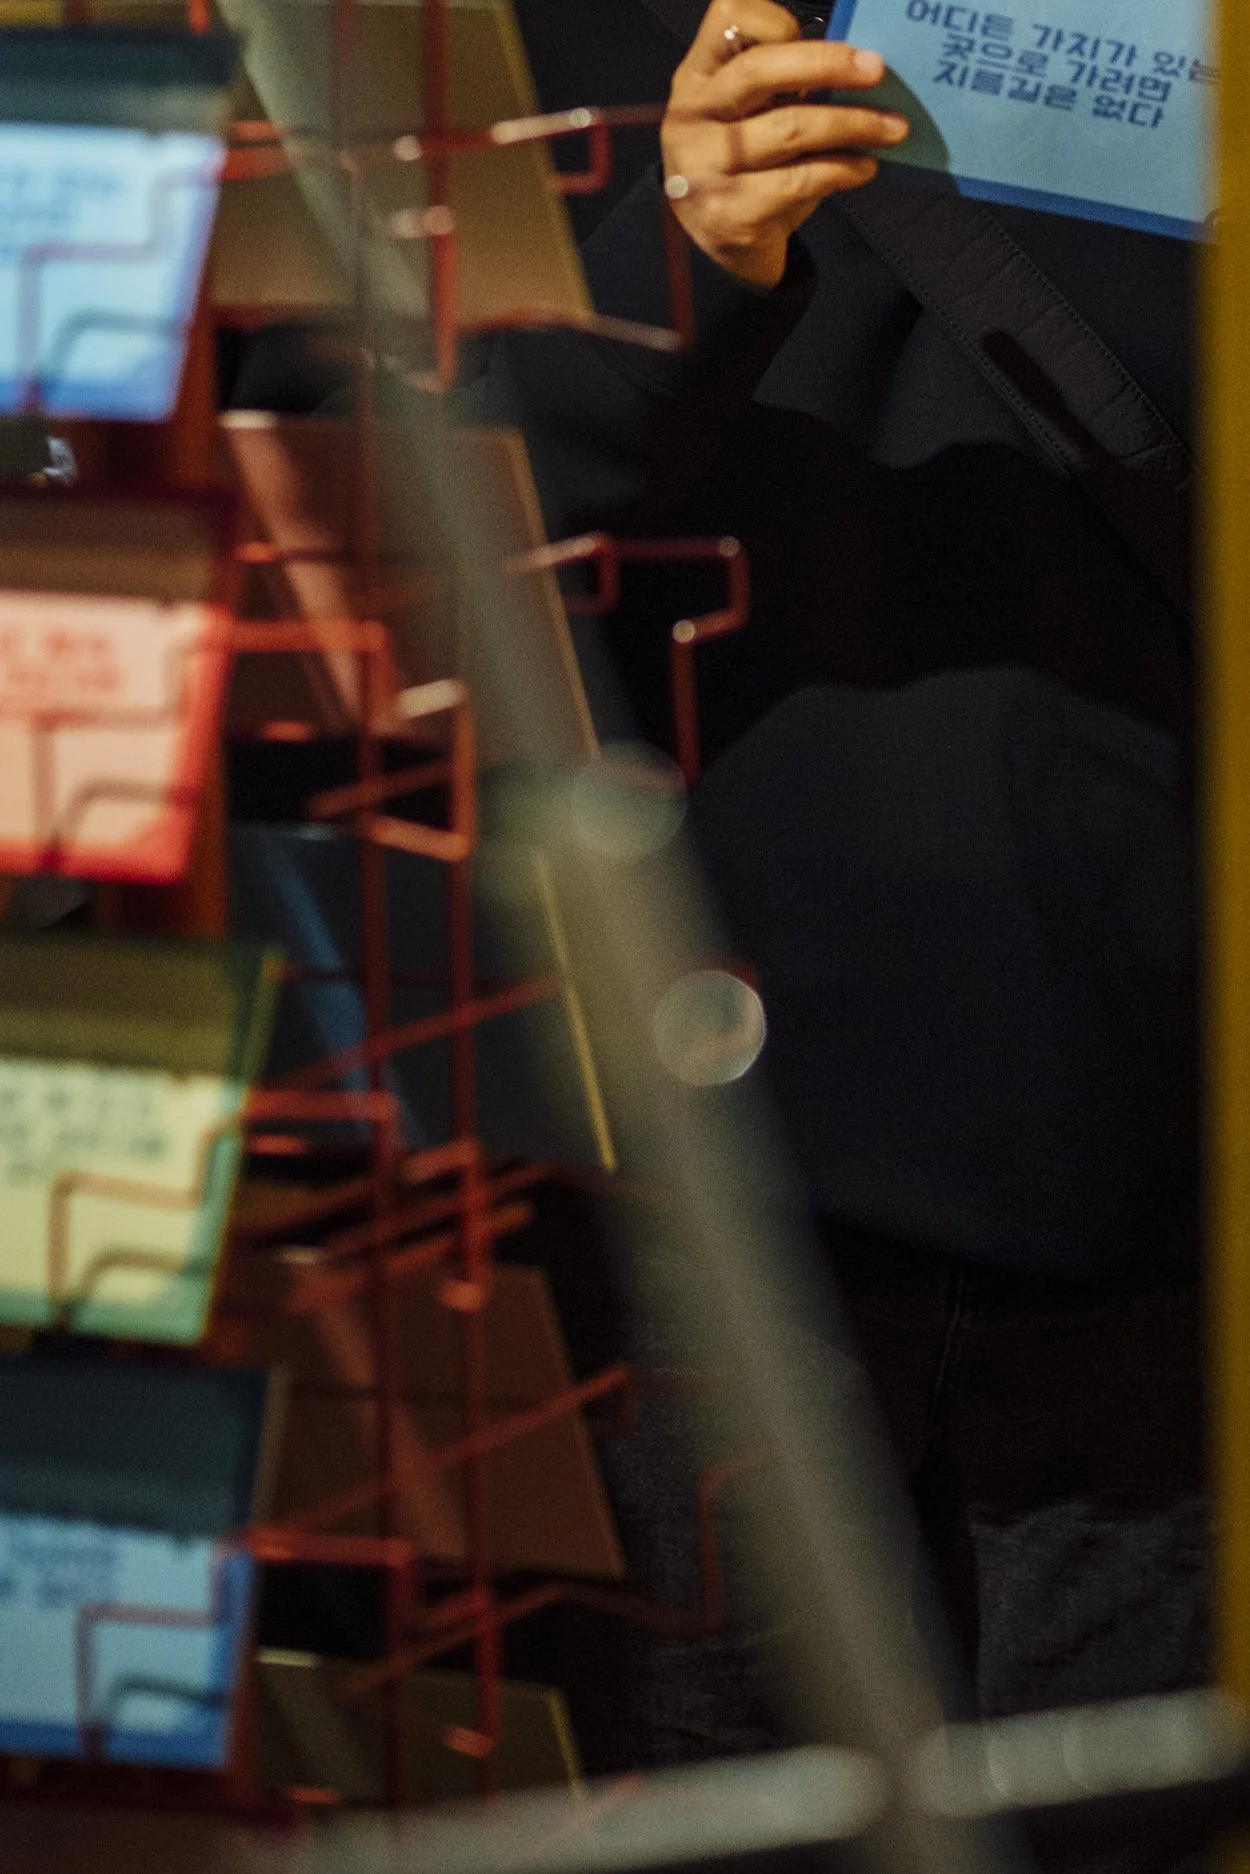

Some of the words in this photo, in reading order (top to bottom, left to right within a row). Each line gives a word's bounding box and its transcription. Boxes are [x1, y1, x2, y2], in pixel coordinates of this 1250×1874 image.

[941, 32, 1050, 78] 곳으로
[1066, 58, 1172, 103] 가려면
[1092, 94, 1164, 129] 없다
